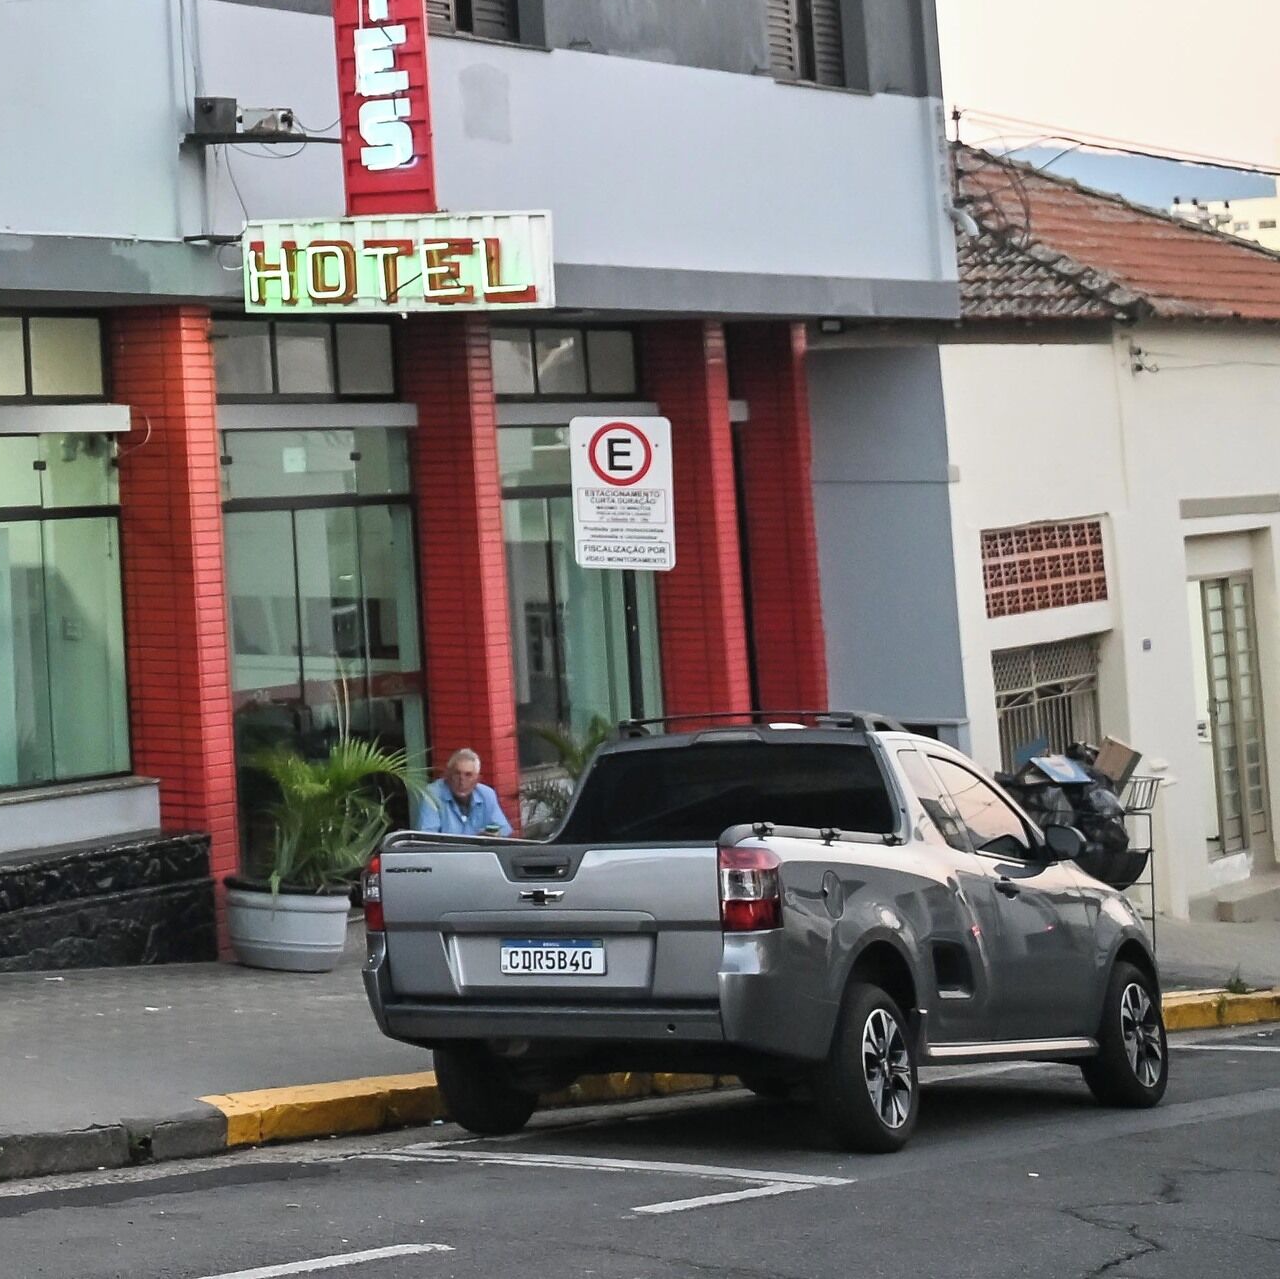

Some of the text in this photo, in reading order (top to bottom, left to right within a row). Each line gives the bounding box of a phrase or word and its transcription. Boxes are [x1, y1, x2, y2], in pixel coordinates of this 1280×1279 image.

[247, 237, 537, 306] HOTEL
[607, 438, 633, 471] E
[584, 489, 660, 498] ESTACIONAMENTO
[583, 545, 666, 554] FISCALIZAÇÃO POR
[509, 950, 592, 970] CDR5B40
